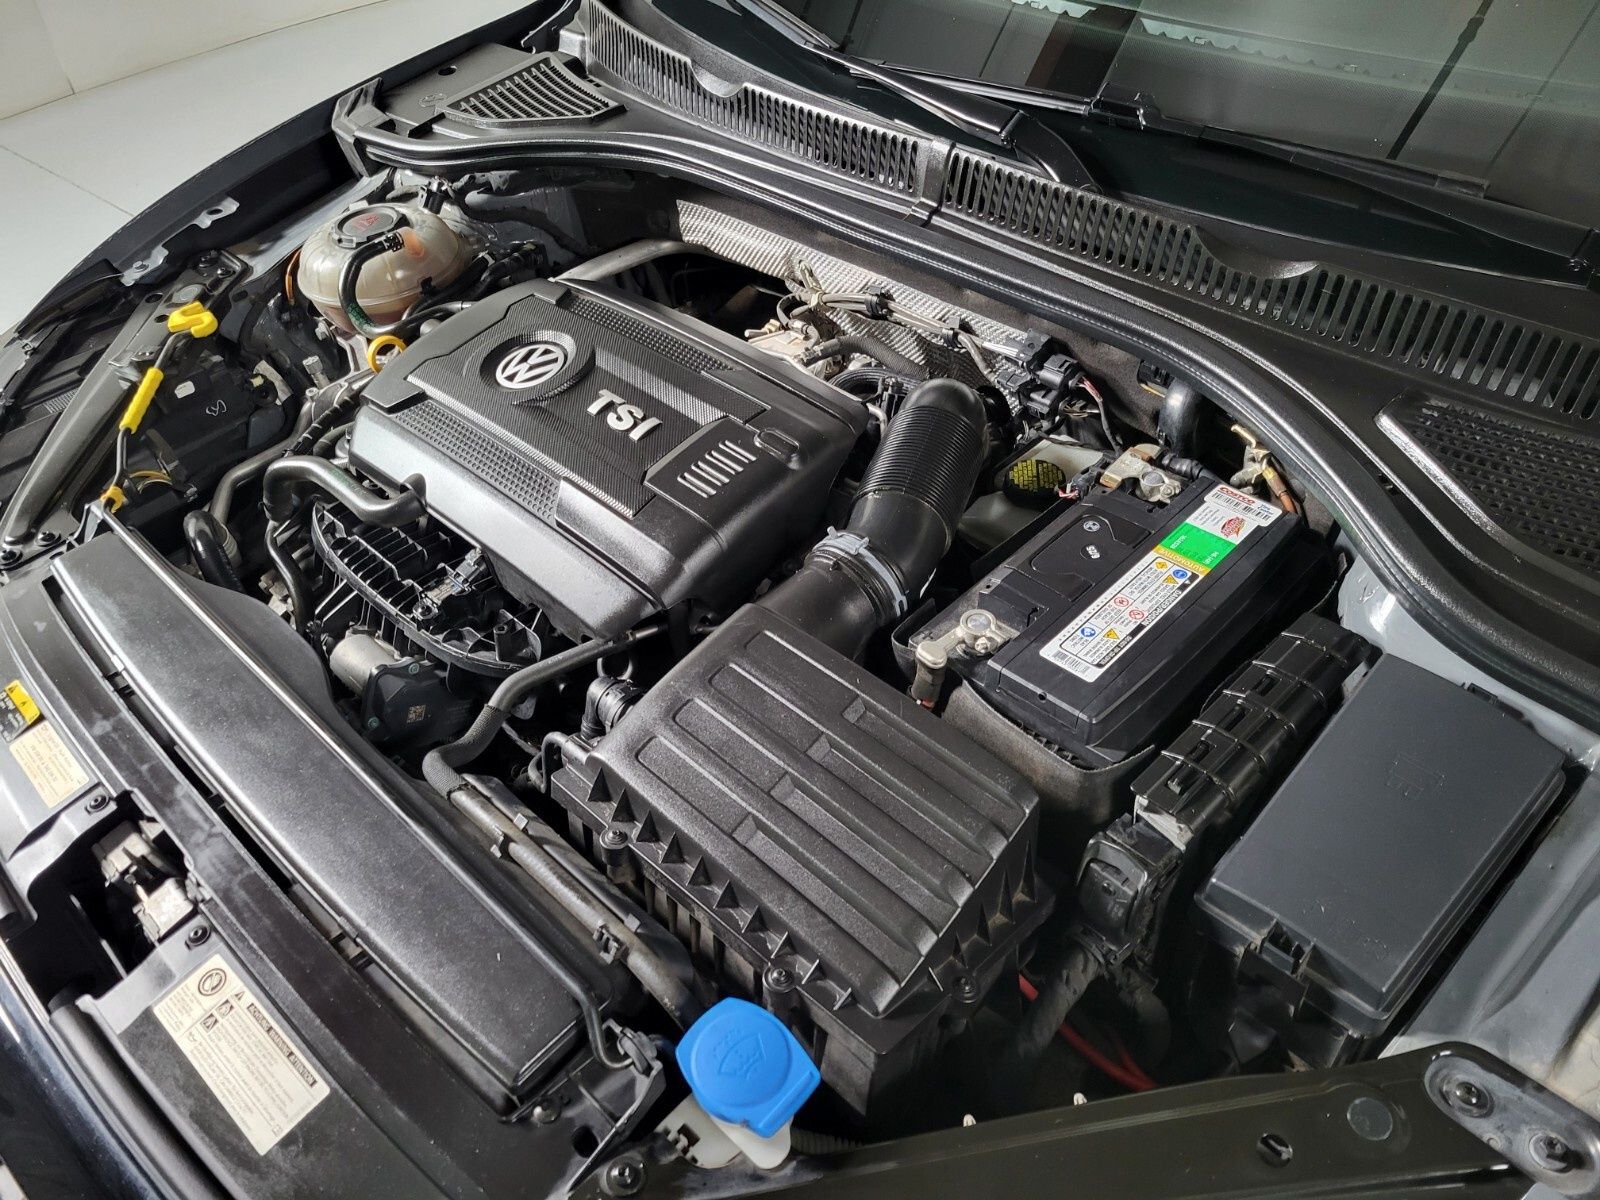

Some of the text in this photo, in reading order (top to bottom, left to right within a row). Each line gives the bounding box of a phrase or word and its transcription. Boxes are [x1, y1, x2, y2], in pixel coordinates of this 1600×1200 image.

[586, 389, 663, 443] TSI
[1219, 486, 1257, 506] COSTCO
[1159, 548, 1205, 573] AUTOMOTIVE
[1140, 589, 1182, 626] DANGER/POISON
[288, 1054, 316, 1085] ATTENTION
